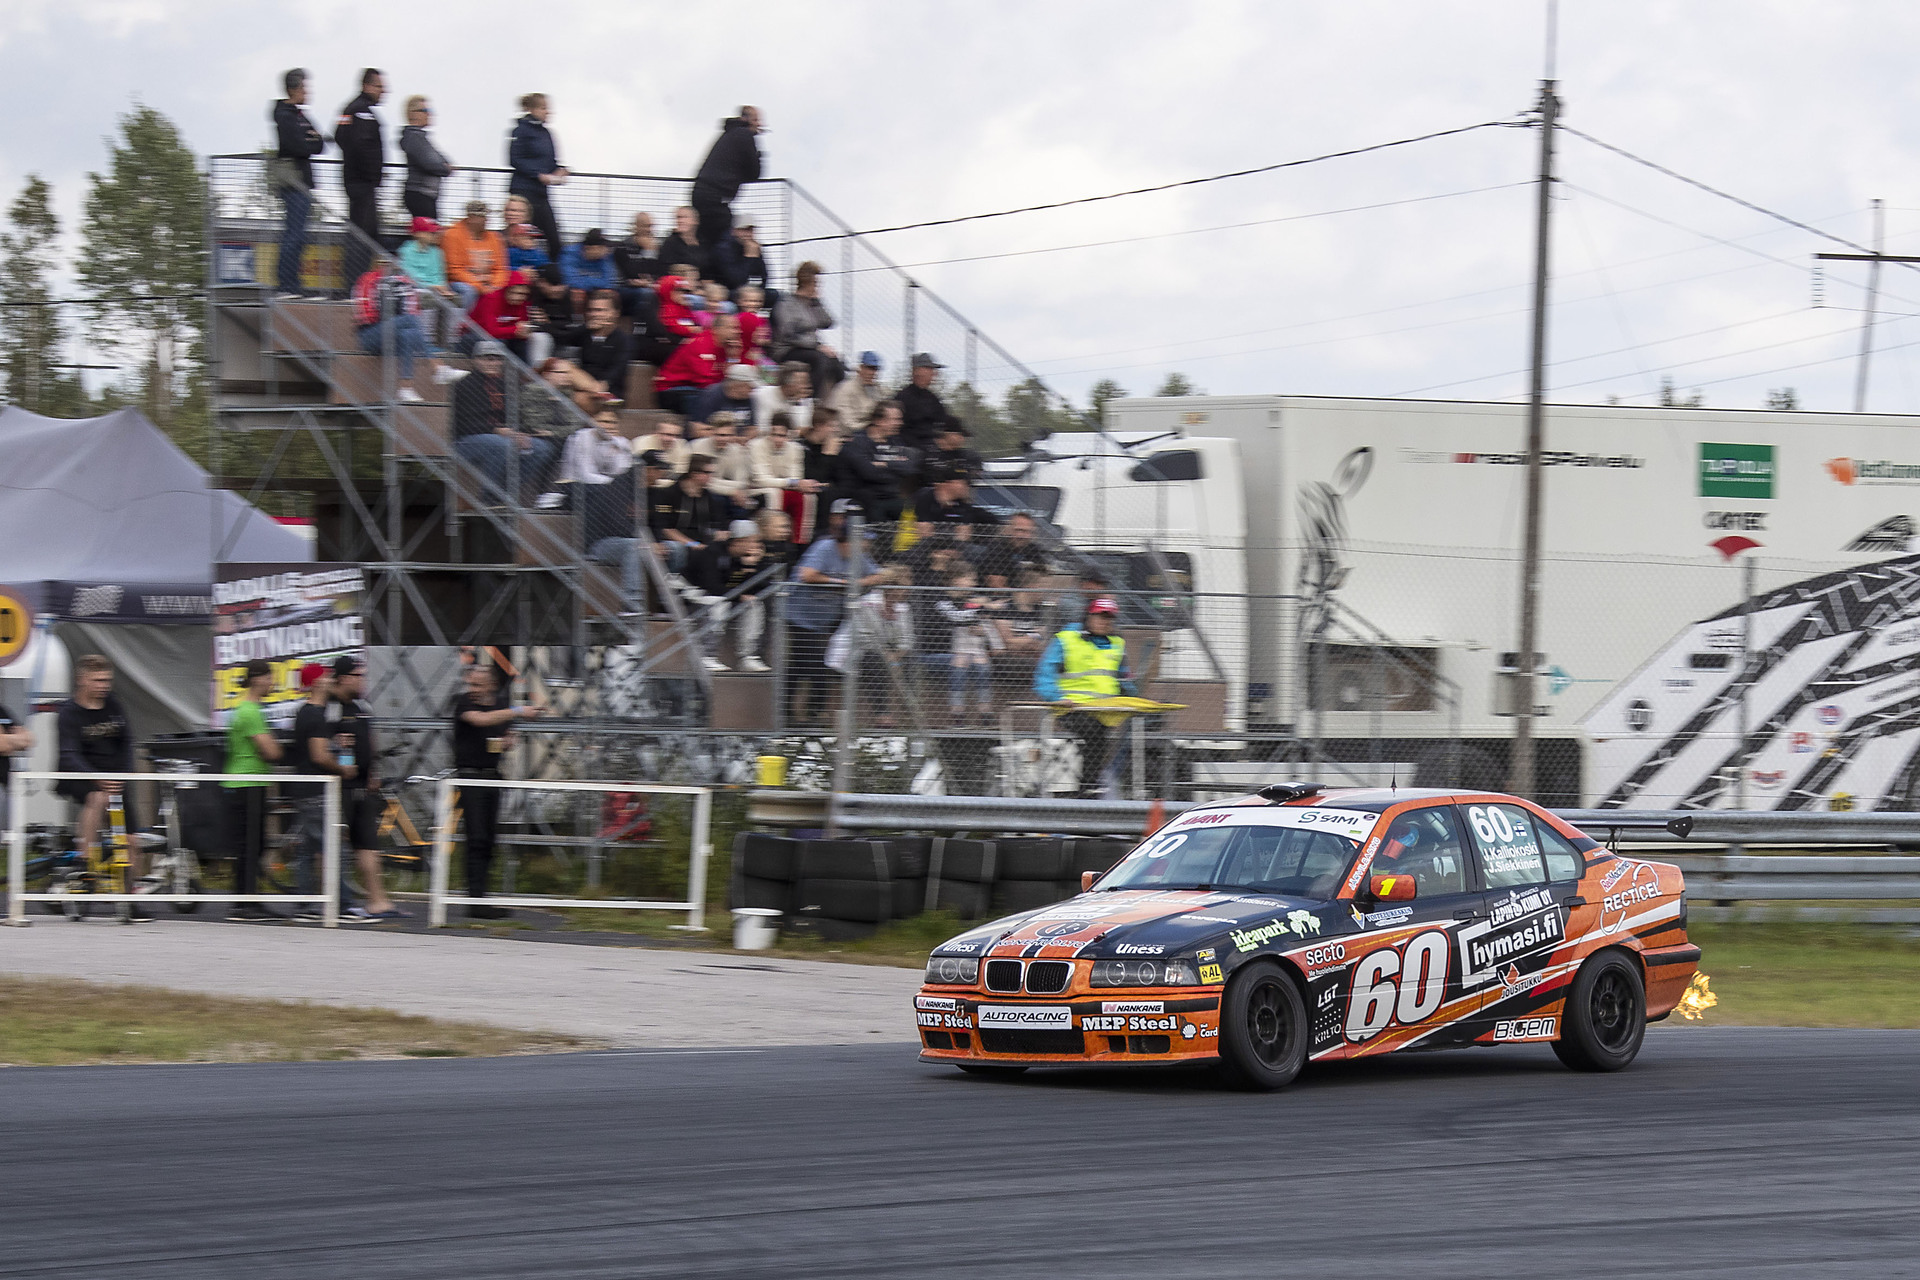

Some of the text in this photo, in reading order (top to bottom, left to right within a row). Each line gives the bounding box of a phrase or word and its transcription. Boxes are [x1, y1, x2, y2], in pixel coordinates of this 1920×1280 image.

[1181, 814, 1234, 827] AVANT
[1319, 814, 1359, 825] SAMI
[1469, 806, 1513, 843] 60
[1127, 833, 1188, 858] 60
[1483, 842, 1540, 861] J.Kalliokoski
[1488, 859, 1541, 873] J.Siekkinen
[1380, 878, 1397, 896] 1
[1229, 919, 1290, 948] ideapark
[1473, 912, 1558, 967] hymasi.fi
[1115, 943, 1165, 954] Uness
[1305, 942, 1345, 966] secto
[1317, 983, 1339, 1008] LGT
[1344, 929, 1449, 1044] 60
[1501, 974, 1542, 999] JOUSITUKKU
[924, 1000, 955, 1009] NANKANG
[1116, 1004, 1163, 1012] NANKANG
[917, 1012, 943, 1027] MEP
[981, 1012, 1069, 1023] AUTORACING
[1081, 1015, 1178, 1031] MEP Steel
[1199, 1026, 1219, 1038] Card
[1314, 1023, 1342, 1045] KIILTO
